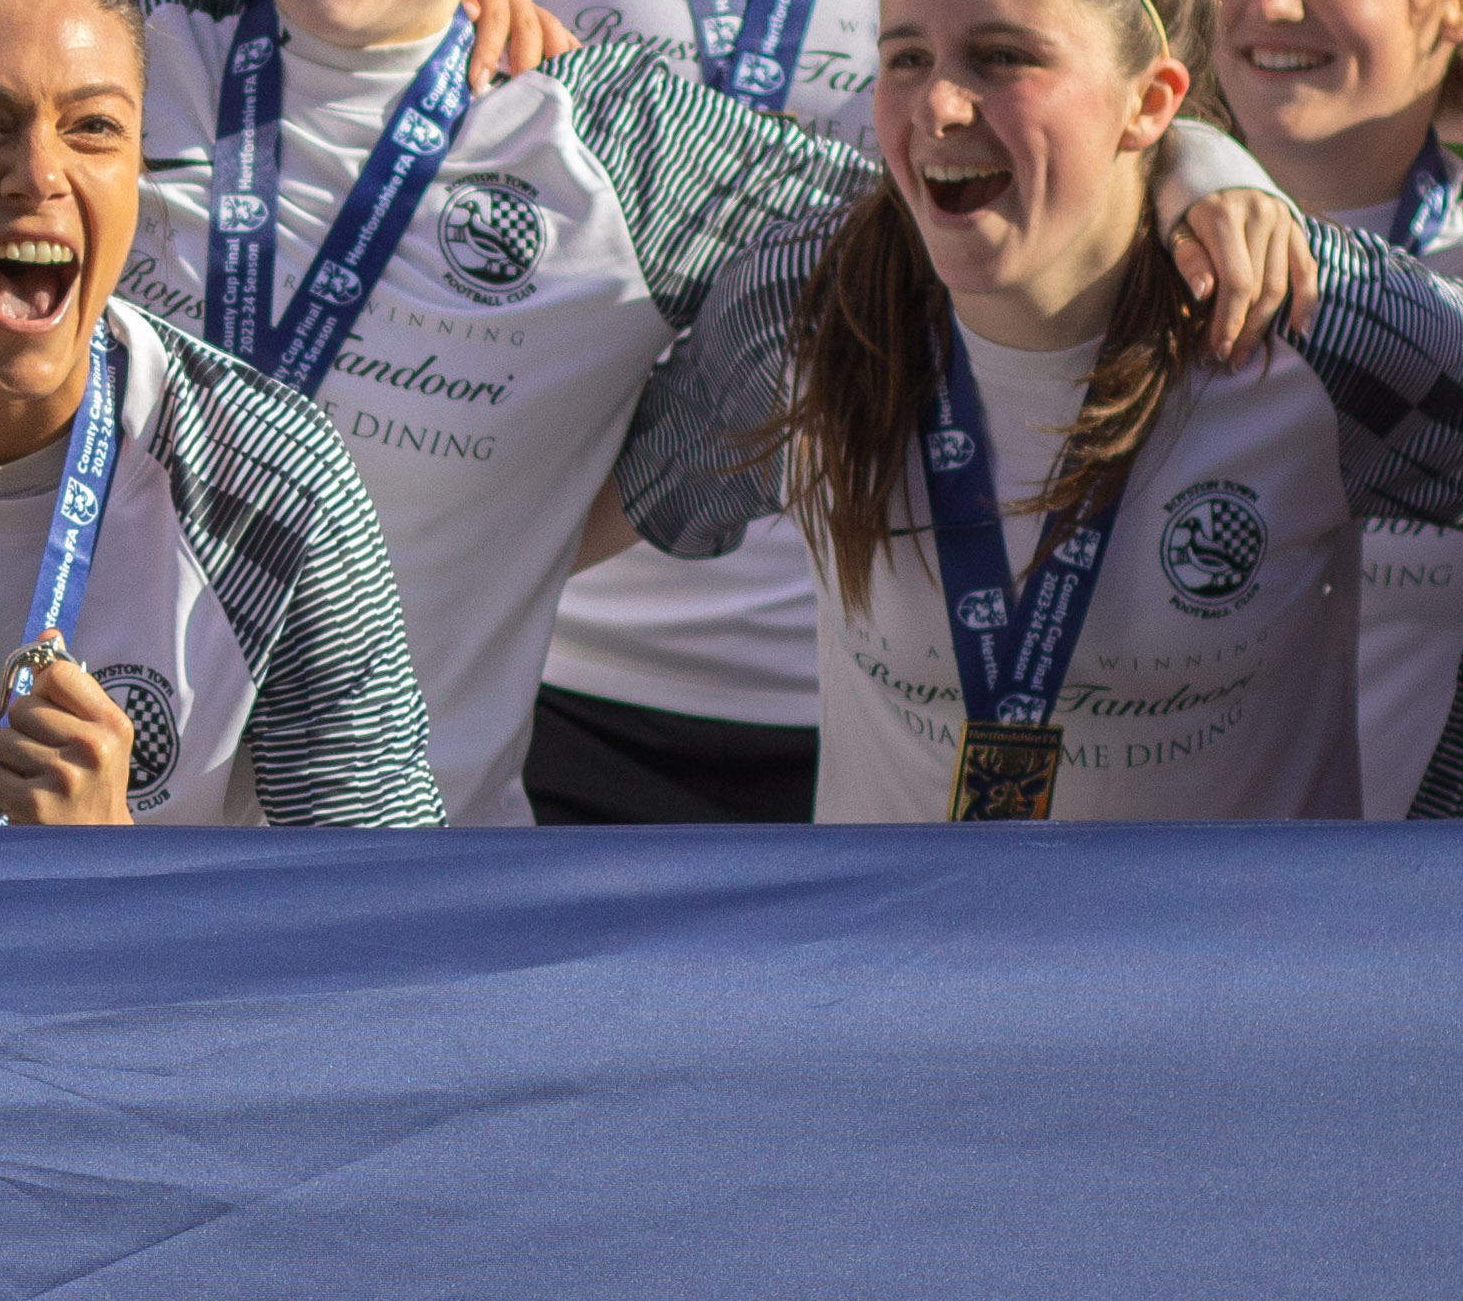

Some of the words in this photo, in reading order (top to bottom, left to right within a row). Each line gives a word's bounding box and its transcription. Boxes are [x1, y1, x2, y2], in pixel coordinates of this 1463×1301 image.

[245, 74, 258, 94] FA
[422, 69, 451, 111] County
[445, 44, 461, 70] Cup
[458, 25, 472, 46] Fin
[238, 95, 256, 191] Hertfordshire
[345, 175, 403, 266] Hertfordshire
[394, 154, 416, 177] FA
[444, 172, 502, 194] ROYSTON
[504, 173, 541, 199] TOWN
[145, 218, 178, 242] HE
[226, 238, 241, 273] Final
[120, 251, 205, 320] Roys
[223, 276, 240, 304] Cup
[243, 243, 260, 293] Season
[442, 272, 503, 306] FOOTBALL
[506, 283, 539, 305] CLUB
[240, 296, 256, 354] 2023-24
[281, 338, 304, 364] Cup
[295, 302, 323, 337] Final
[91, 352, 102, 388] Final
[288, 362, 312, 391] 3-24
[304, 316, 338, 364] Season
[333, 333, 514, 405] andoori
[89, 389, 104, 420] Cup
[77, 421, 99, 474] County
[91, 416, 114, 477] 2023-24
[351, 410, 496, 461] DINING
[44, 548, 75, 629] tfordshire
[65, 528, 79, 550] FA
[1030, 571, 1059, 630] 2023-24
[1051, 573, 1079, 624] County
[1362, 564, 1453, 588] NING
[1014, 631, 1041, 681] Season
[1040, 626, 1063, 653] Cup
[93, 663, 143, 684] OYSTON
[146, 667, 174, 698] TOWN
[855, 652, 960, 705] Roys
[1054, 661, 1264, 718] Tandoori
[1030, 655, 1053, 691] Final
[1127, 706, 1243, 769] DINING
[137, 789, 172, 813] CLUB
